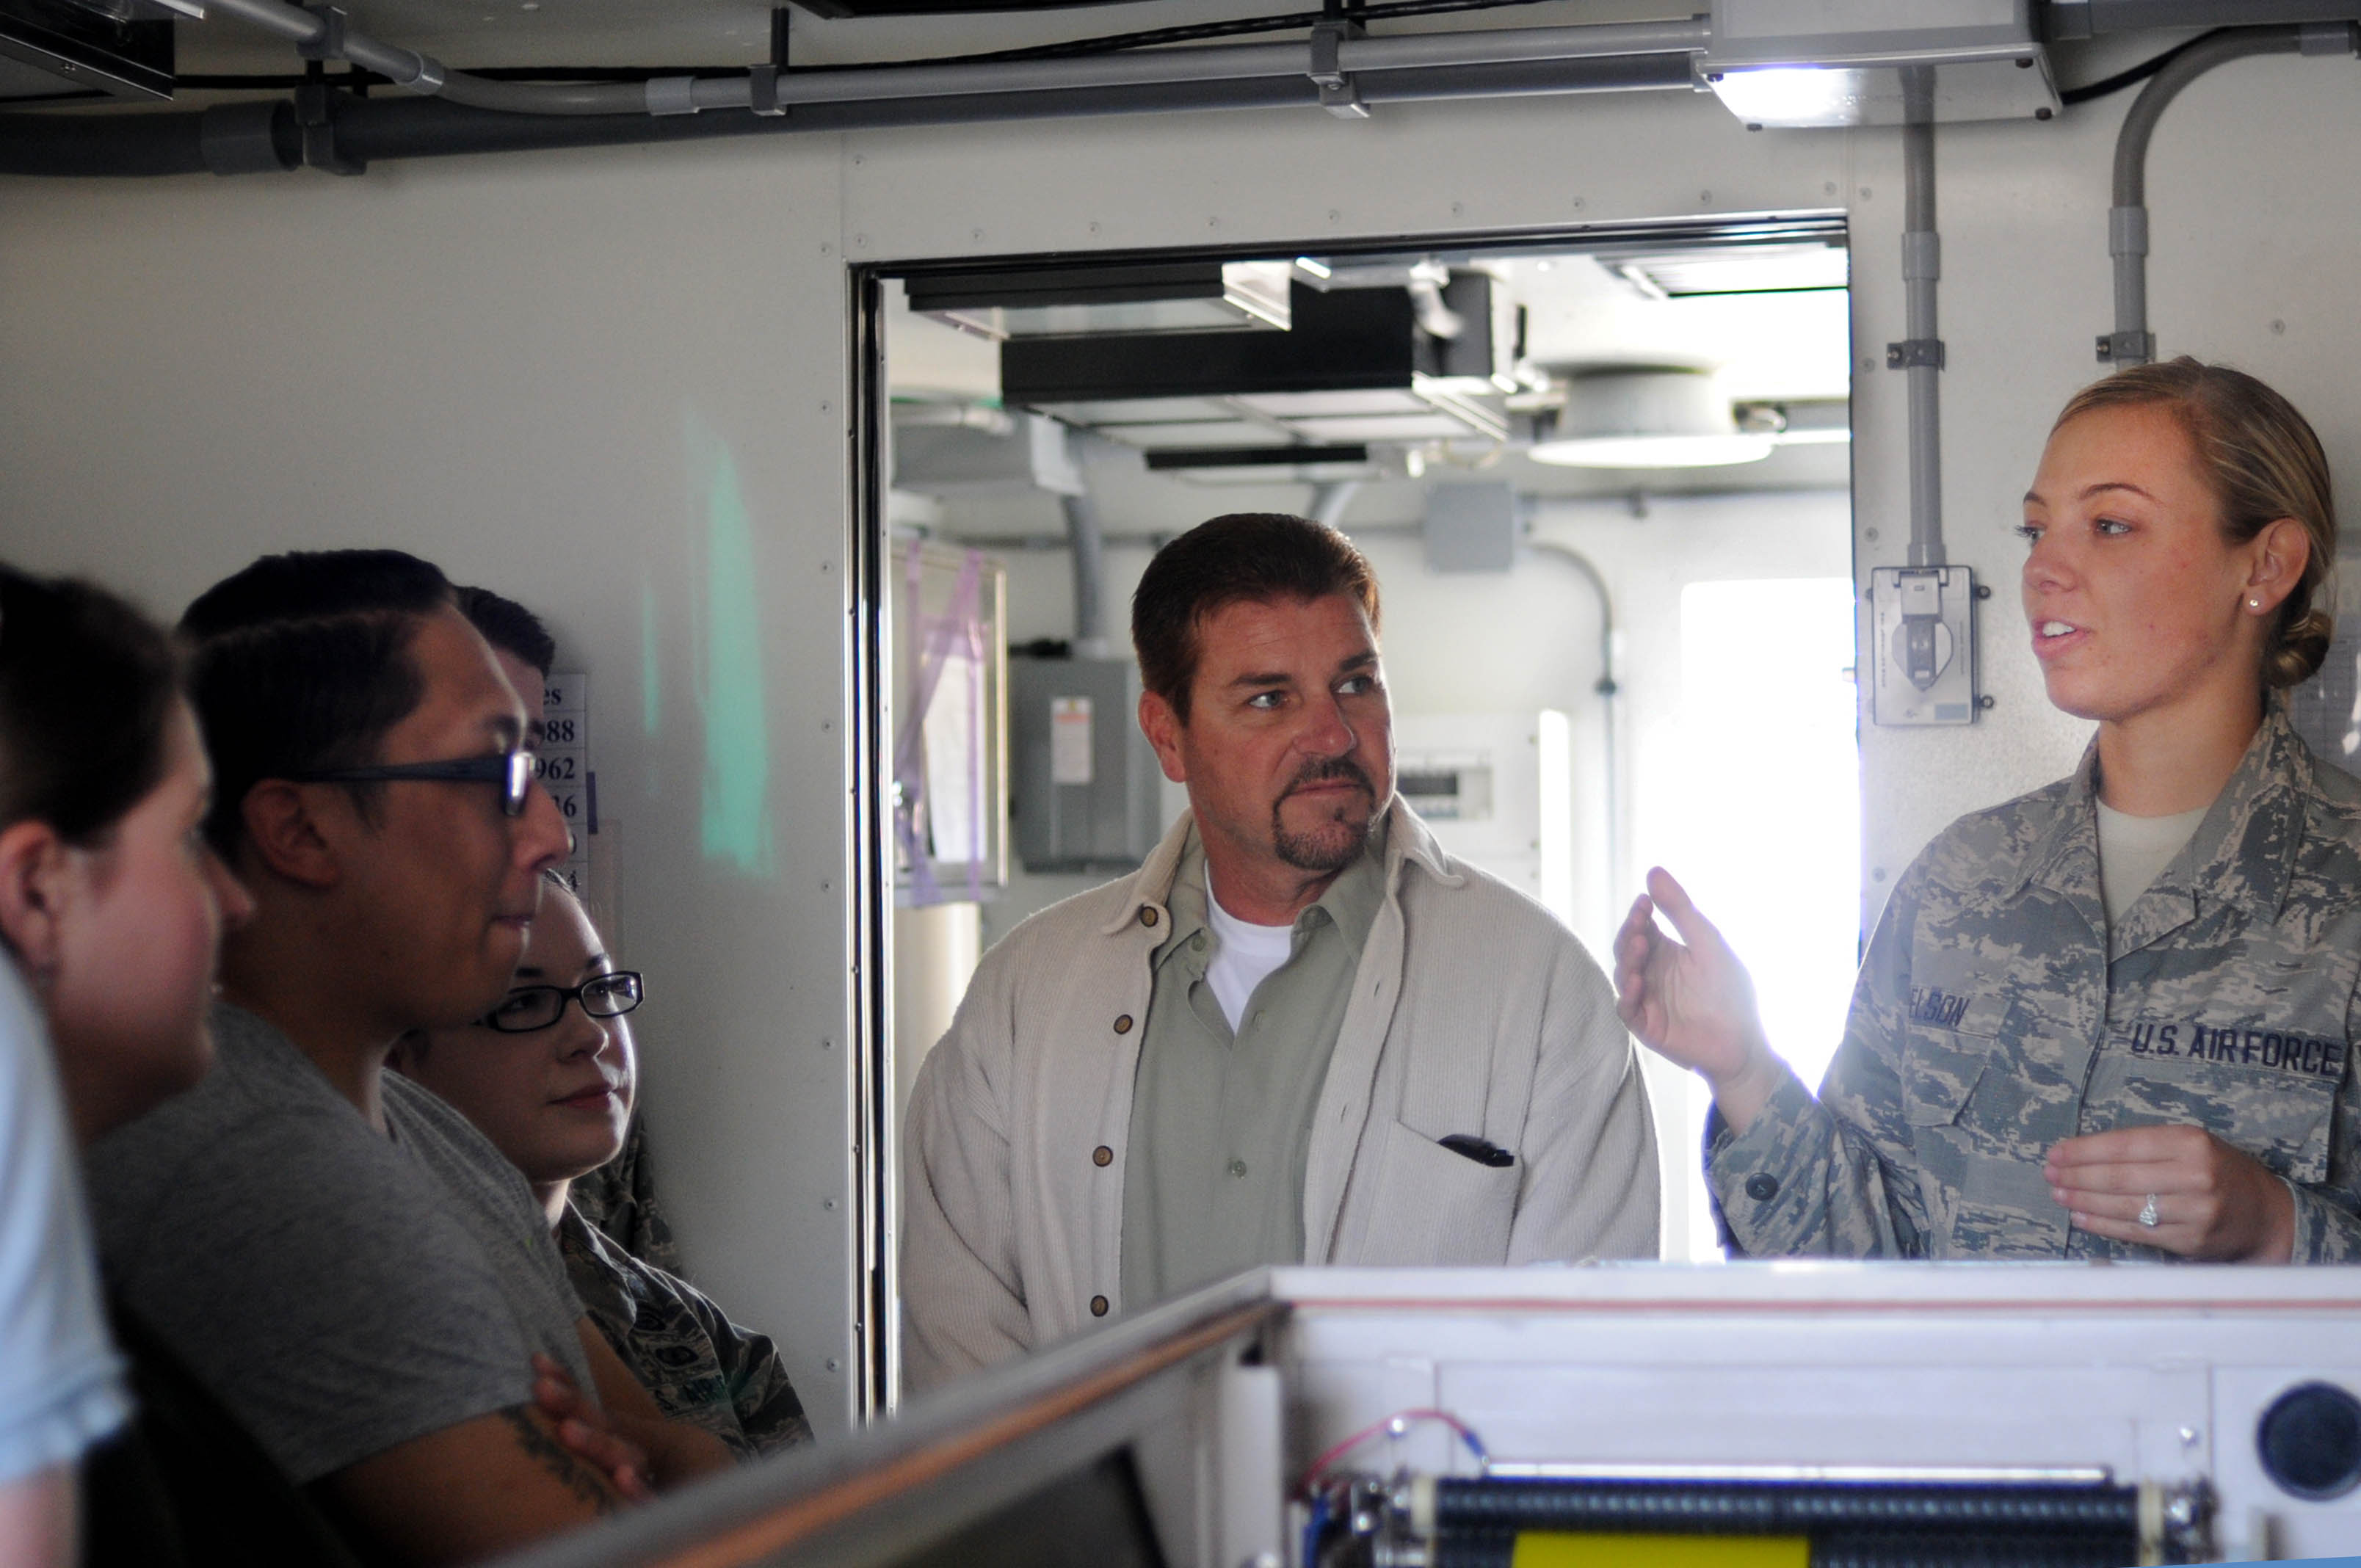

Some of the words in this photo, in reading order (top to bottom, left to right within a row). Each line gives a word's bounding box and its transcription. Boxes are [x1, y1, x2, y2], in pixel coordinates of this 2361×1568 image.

[543, 719, 575, 741] 88
[2131, 1023, 2180, 1056] U.S.
[2187, 1025, 2238, 1063] AIR
[2241, 1031, 2345, 1077] FORCE
